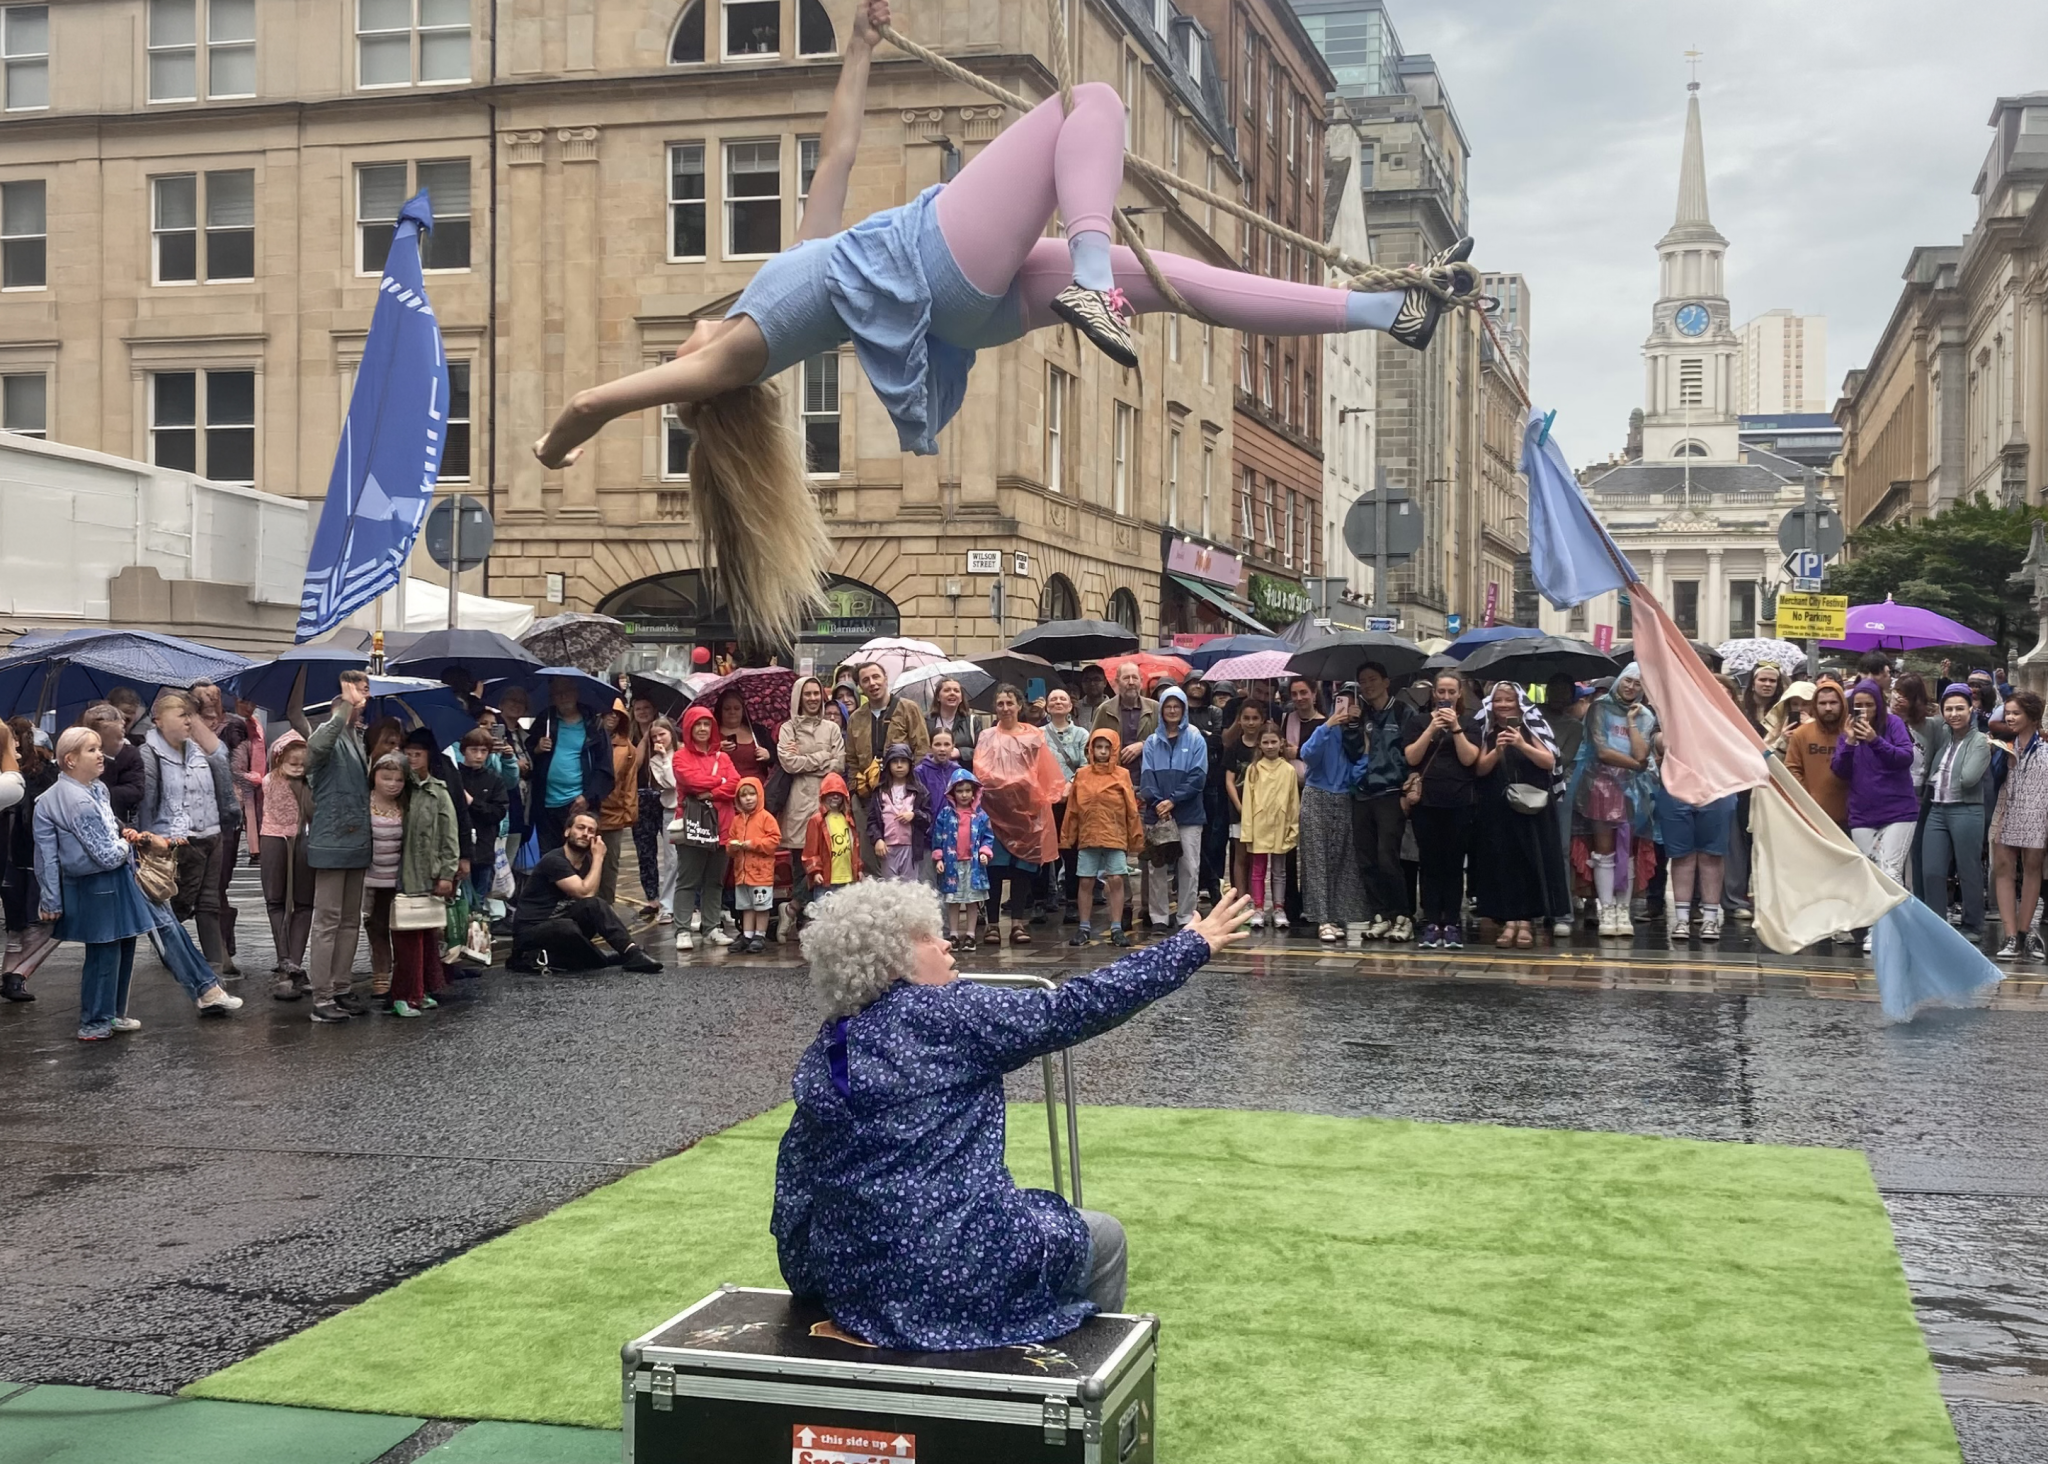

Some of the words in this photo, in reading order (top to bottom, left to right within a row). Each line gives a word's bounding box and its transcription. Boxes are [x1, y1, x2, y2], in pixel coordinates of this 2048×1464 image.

[972, 552, 997, 560] WILSON
[972, 560, 997, 568] STREET
[1804, 553, 1819, 576] P
[1779, 595, 1808, 606] Merchant
[1808, 596, 1820, 609] City
[1822, 596, 1846, 608] Festival
[1792, 610, 1803, 621] No
[1804, 611, 1832, 625] Parking
[635, 623, 679, 633] Barnardo's
[830, 624, 876, 633] Barnardo's
[686, 819, 700, 830] Hey!
[686, 826, 696, 834] I'm
[820, 1434, 843, 1445] this
[846, 1436, 869, 1448] side
[872, 1440, 888, 1451] up
